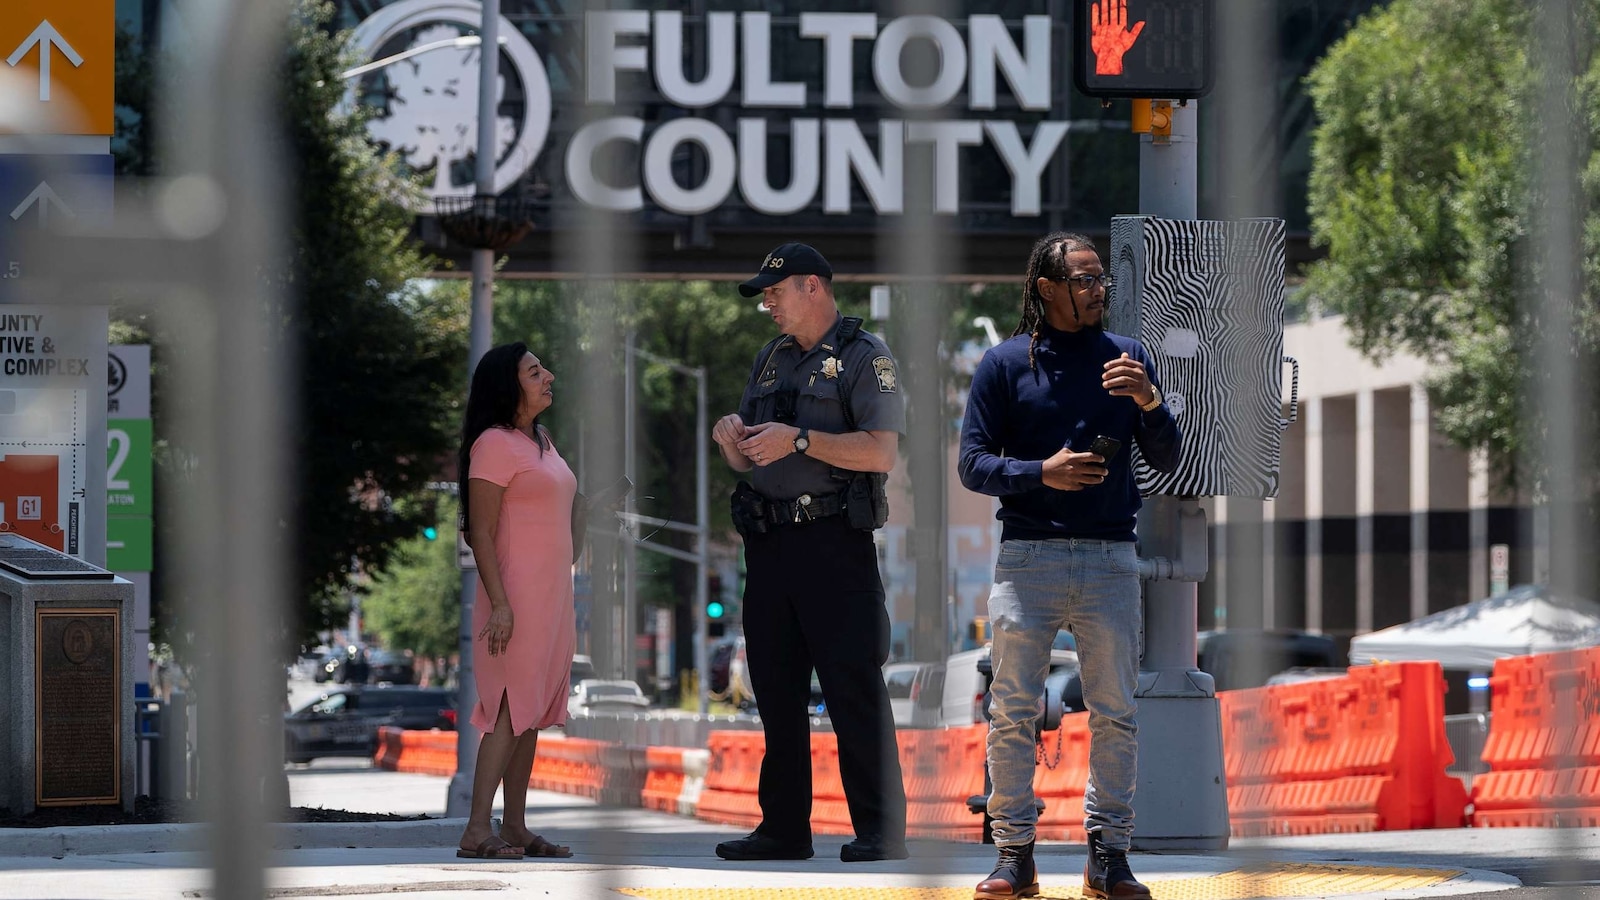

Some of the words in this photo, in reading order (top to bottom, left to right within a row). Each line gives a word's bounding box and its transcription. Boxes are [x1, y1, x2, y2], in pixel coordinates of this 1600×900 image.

[585, 10, 1052, 110] FULTON
[564, 116, 1071, 217] COUNTY
[41, 336, 56, 354] &
[4, 358, 90, 376] COMPLEX
[107, 429, 130, 489] 2
[22, 499, 36, 515] G1
[70, 540, 76, 548] ST
